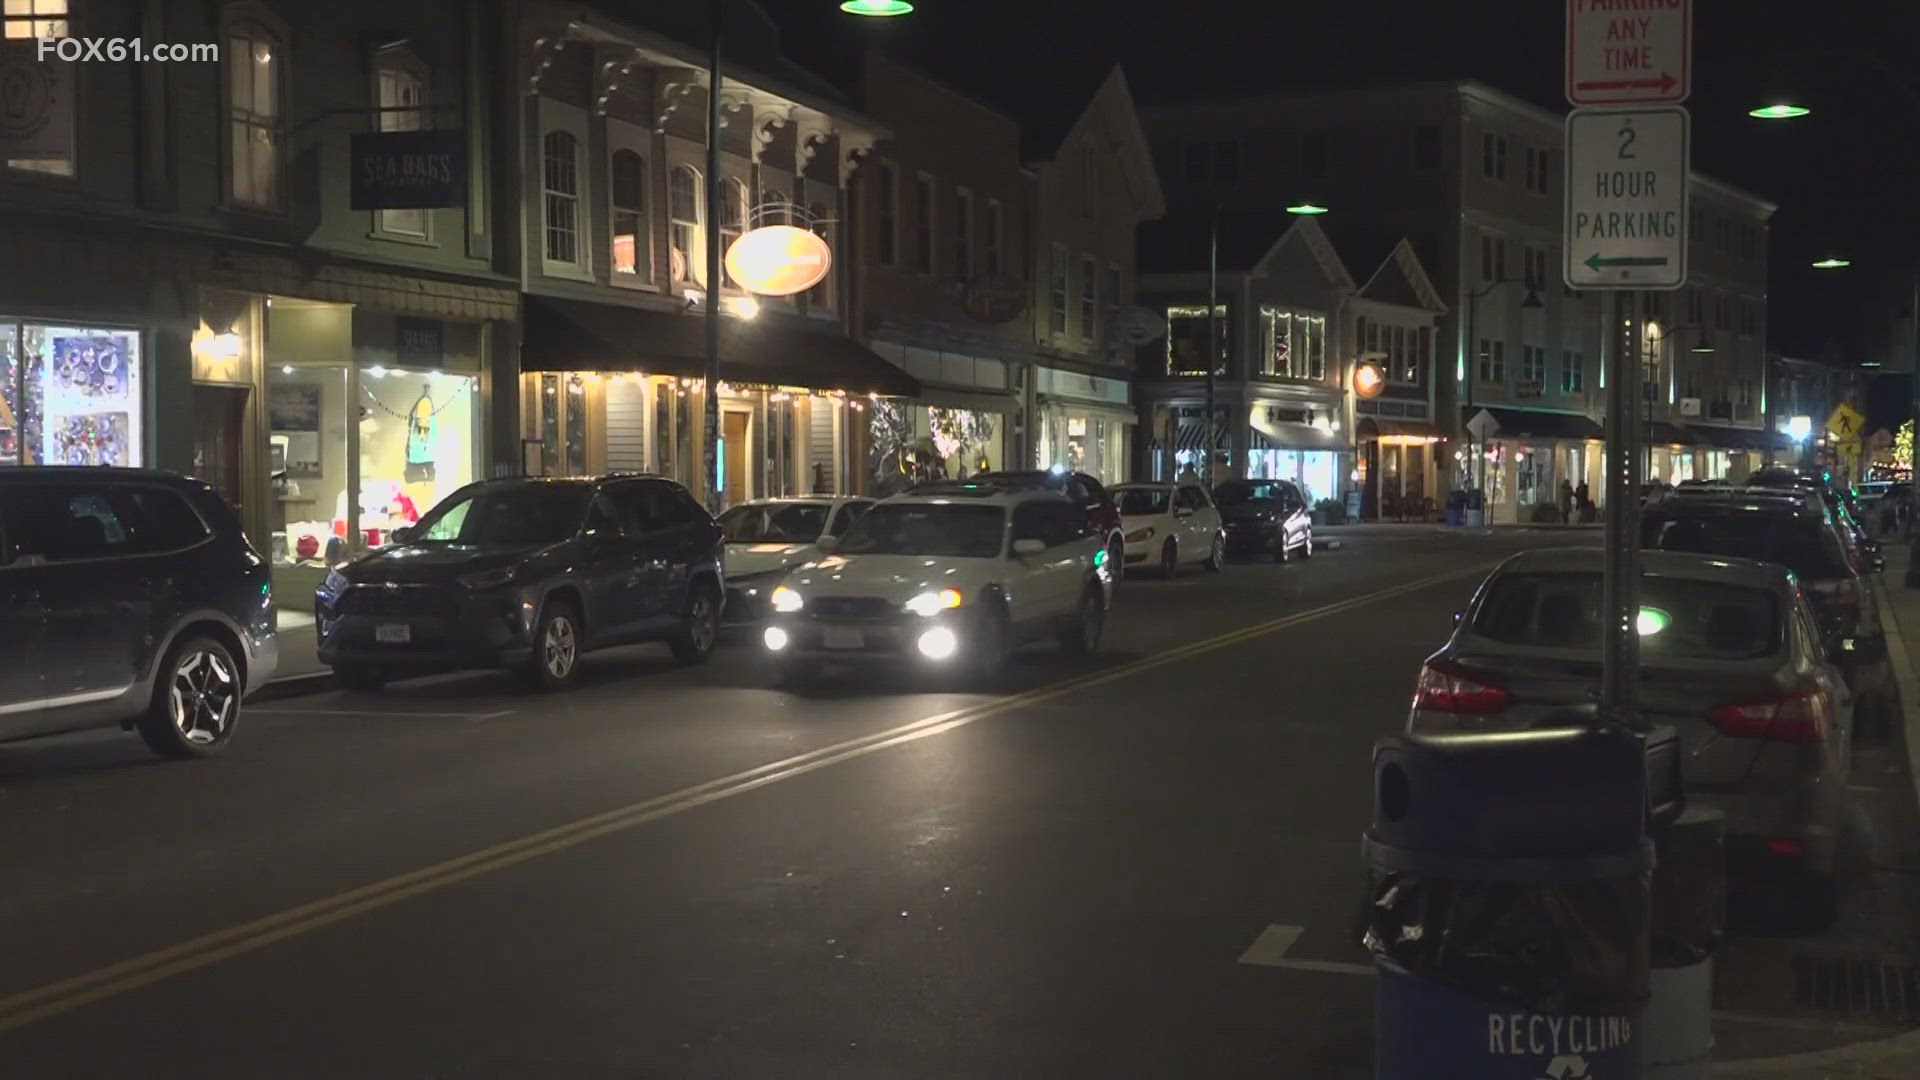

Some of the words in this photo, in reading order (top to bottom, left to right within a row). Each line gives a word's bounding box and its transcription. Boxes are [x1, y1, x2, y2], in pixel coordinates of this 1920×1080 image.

[1607, 16, 1651, 40] ANY
[1603, 46, 1653, 71] TIME
[1617, 127, 1637, 161] 2
[1596, 171, 1657, 198] HOUR
[1575, 210, 1677, 239] PARKING
